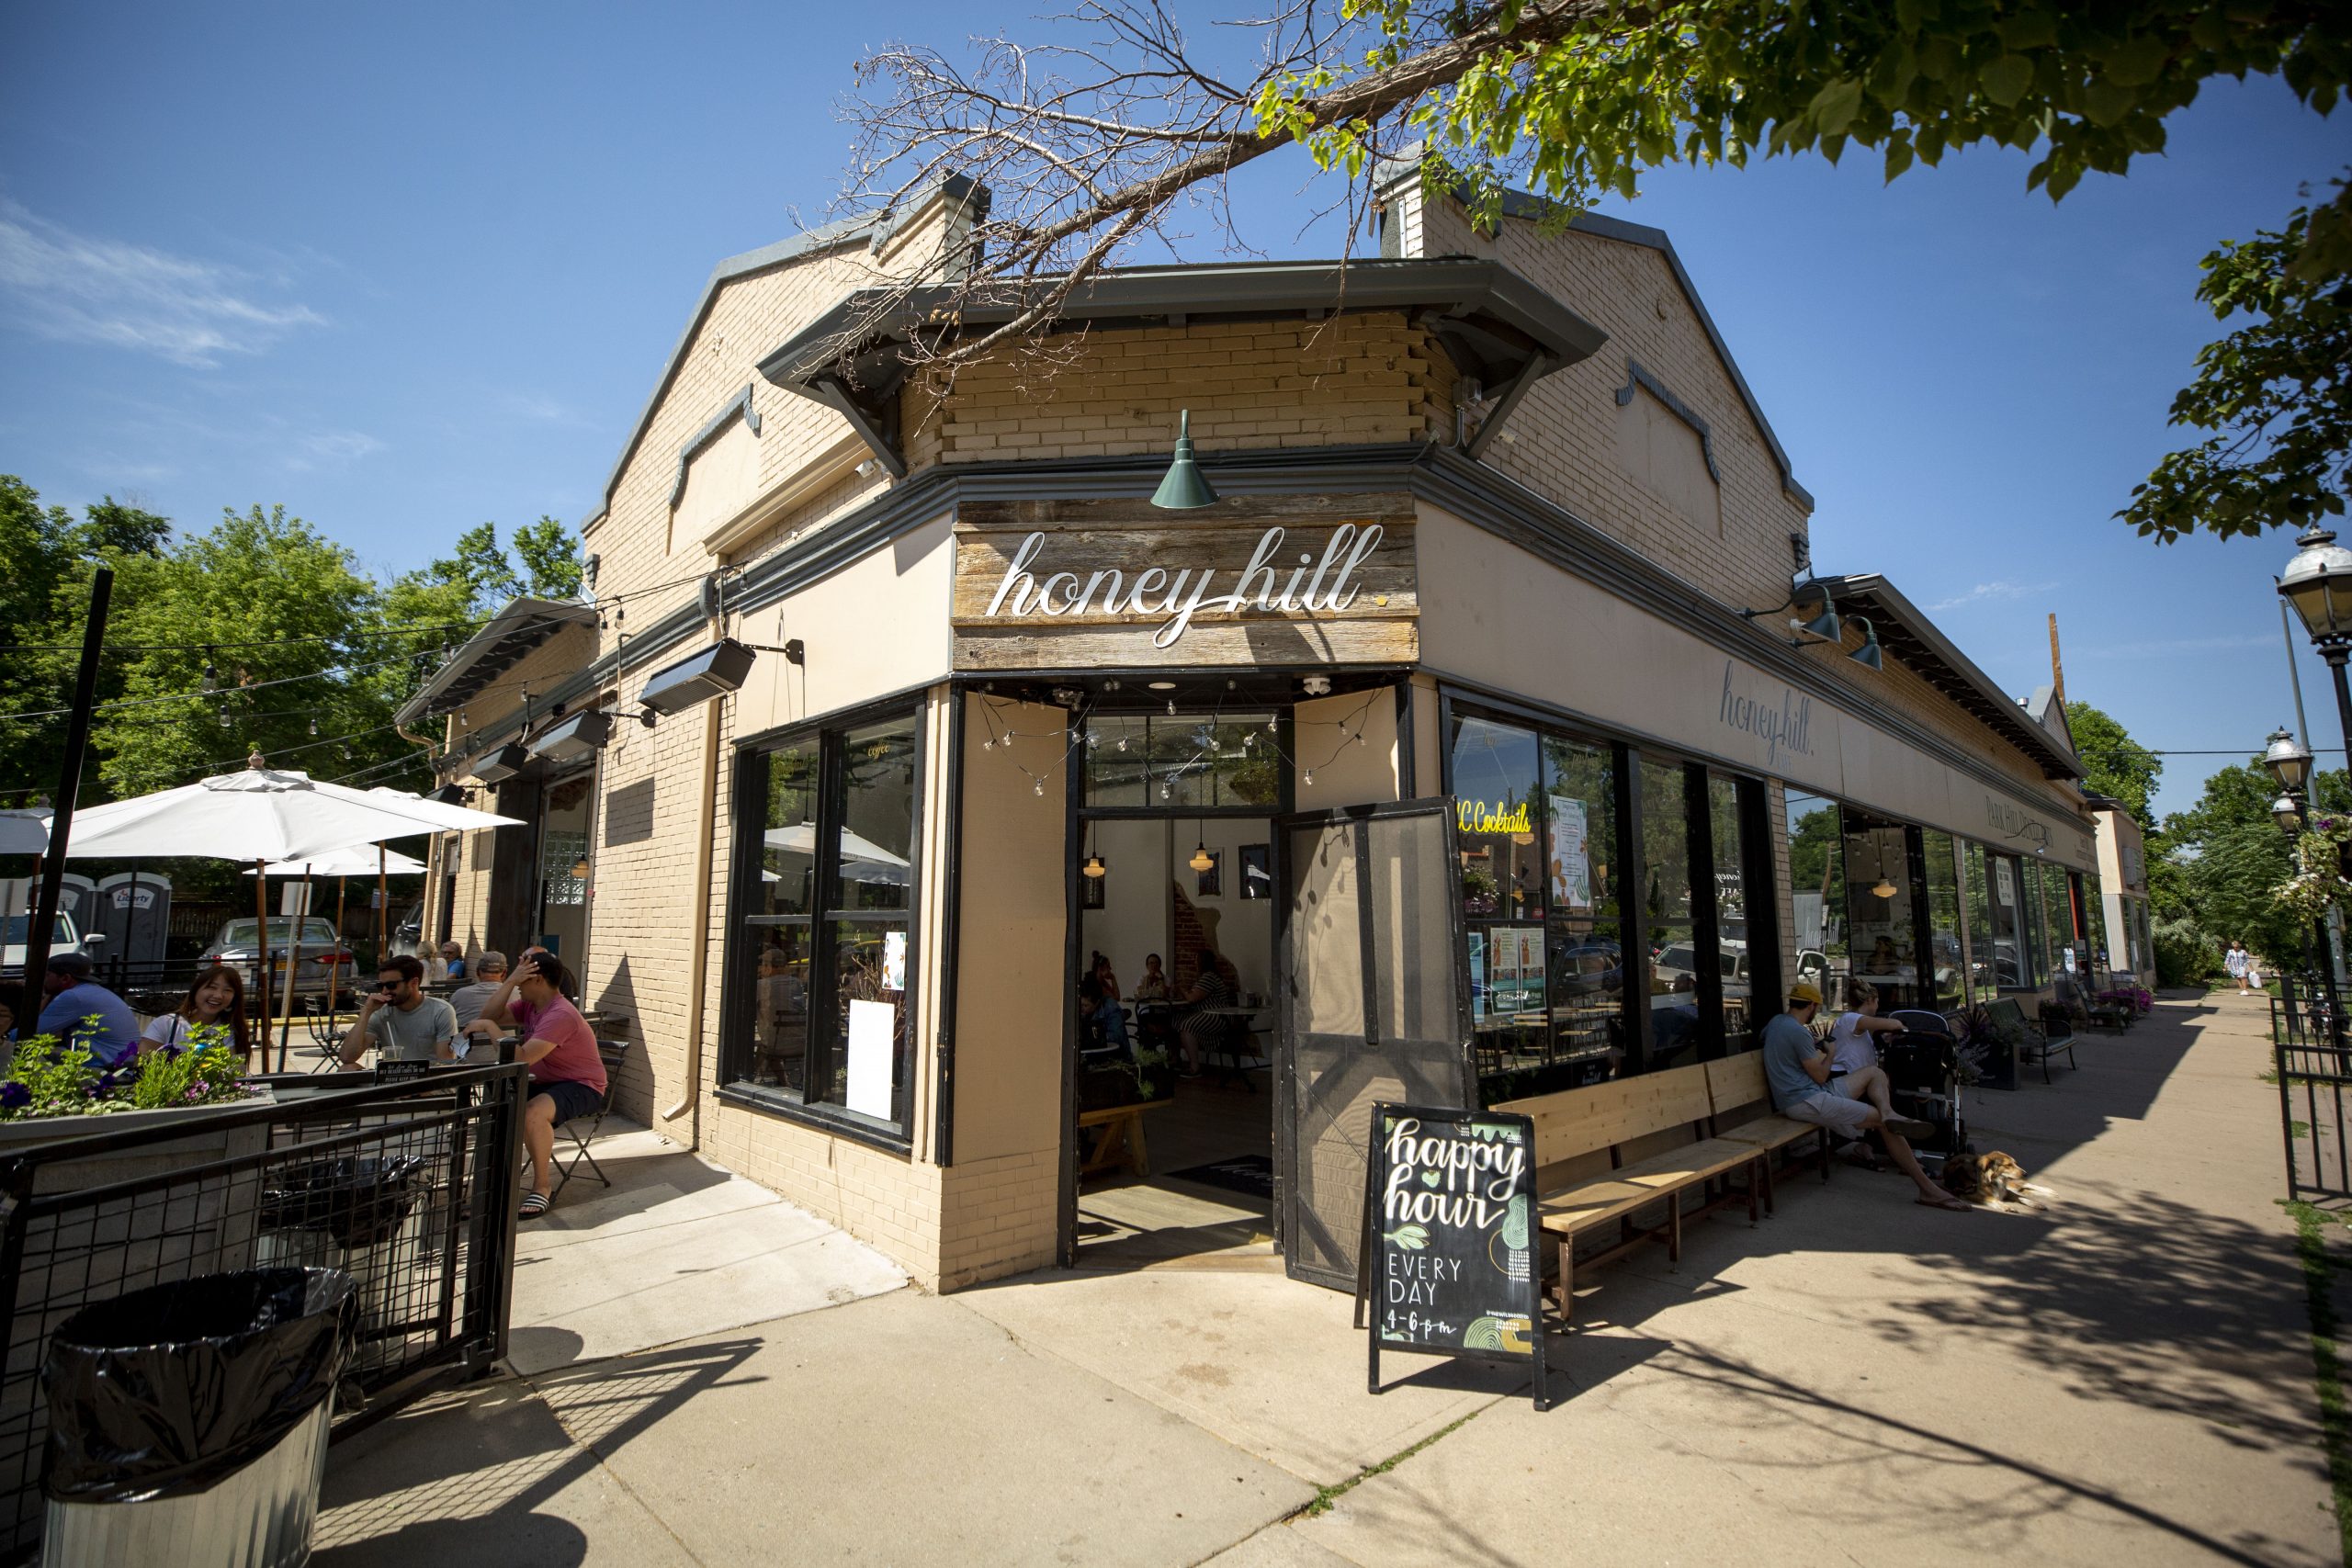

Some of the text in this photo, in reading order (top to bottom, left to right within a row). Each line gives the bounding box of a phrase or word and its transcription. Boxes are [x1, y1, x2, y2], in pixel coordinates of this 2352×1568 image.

[985, 523, 1384, 649] honey hill
[1719, 660, 1779, 766] honey
[867, 737, 890, 760] coffee
[1457, 800, 1532, 833] C Cocktails
[117, 894, 149, 903] Librty
[1385, 1117, 1526, 1201] happy
[1384, 1163, 1505, 1229] hour
[1388, 1253, 1461, 1281] EVERY
[1389, 1279, 1436, 1305] DAY
